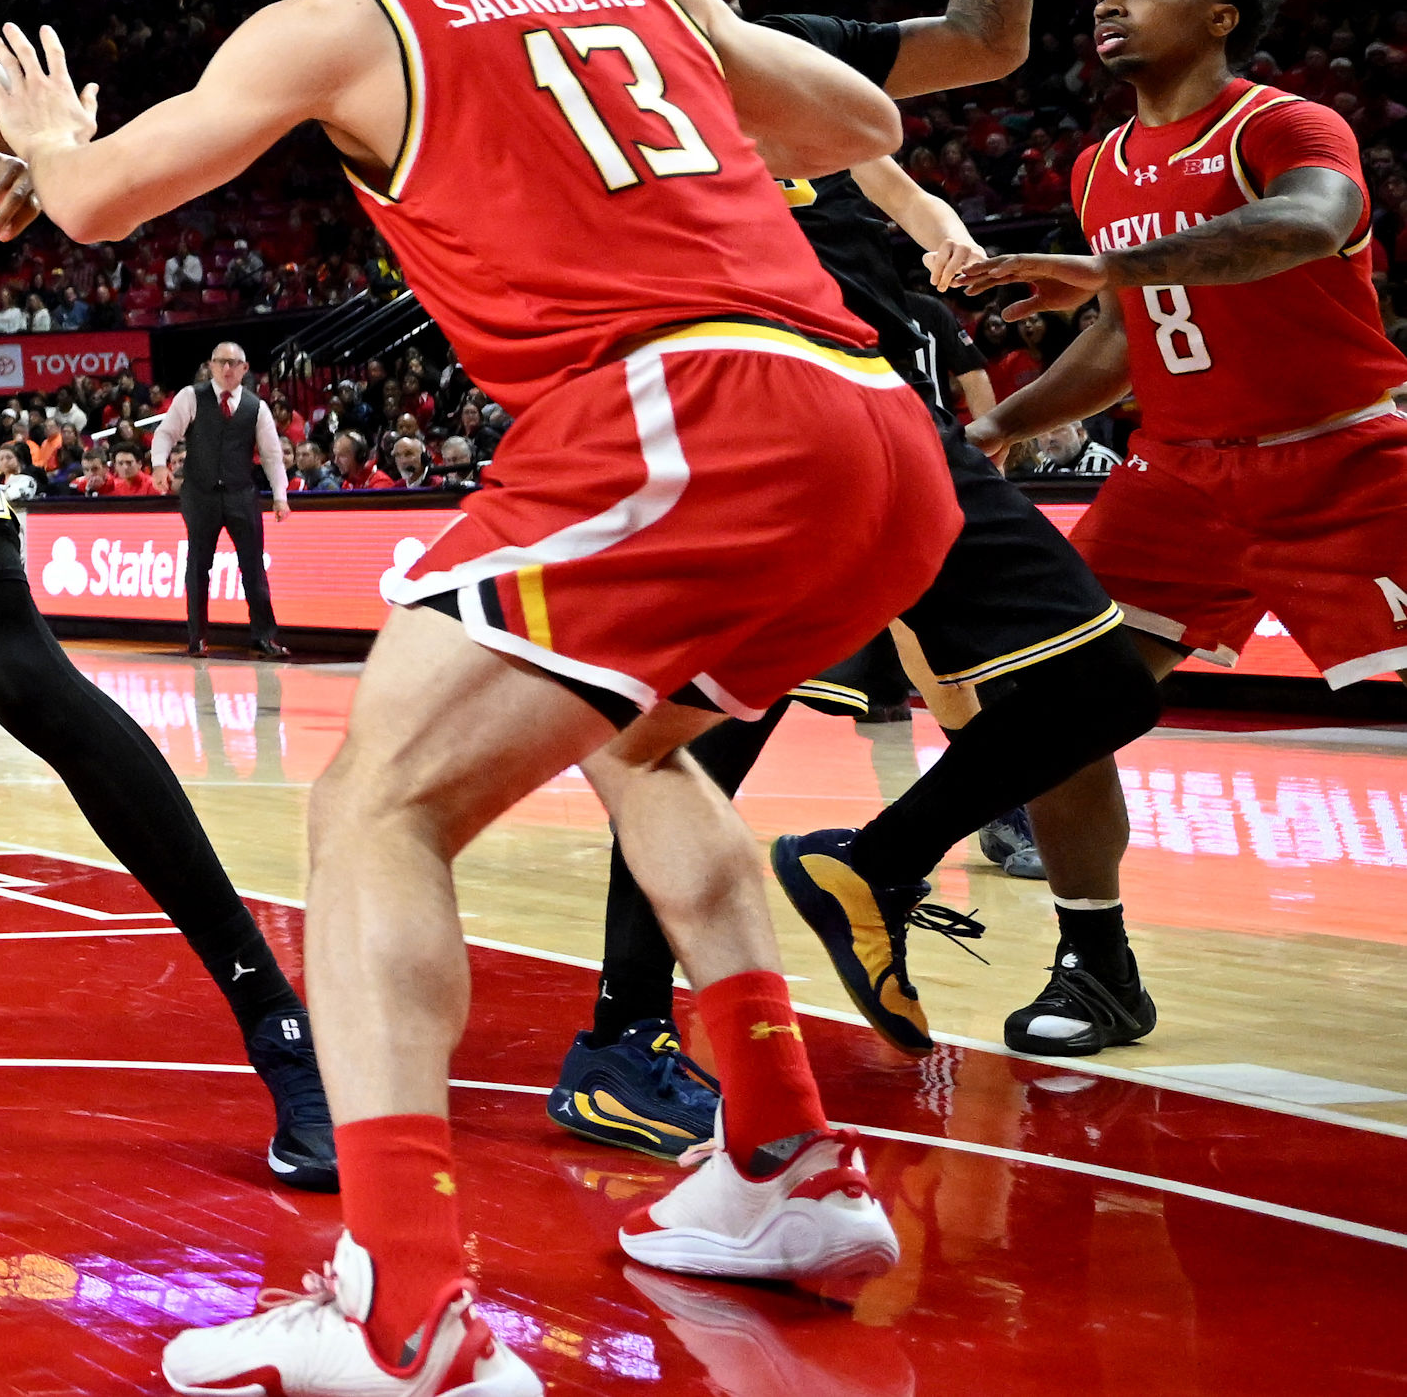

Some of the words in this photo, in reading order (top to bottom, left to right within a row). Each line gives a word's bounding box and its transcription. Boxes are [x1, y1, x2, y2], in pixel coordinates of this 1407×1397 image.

[523, 23, 722, 195] 13
[31, 351, 130, 375] TOYOTA
[1142, 284, 1212, 375] 8
